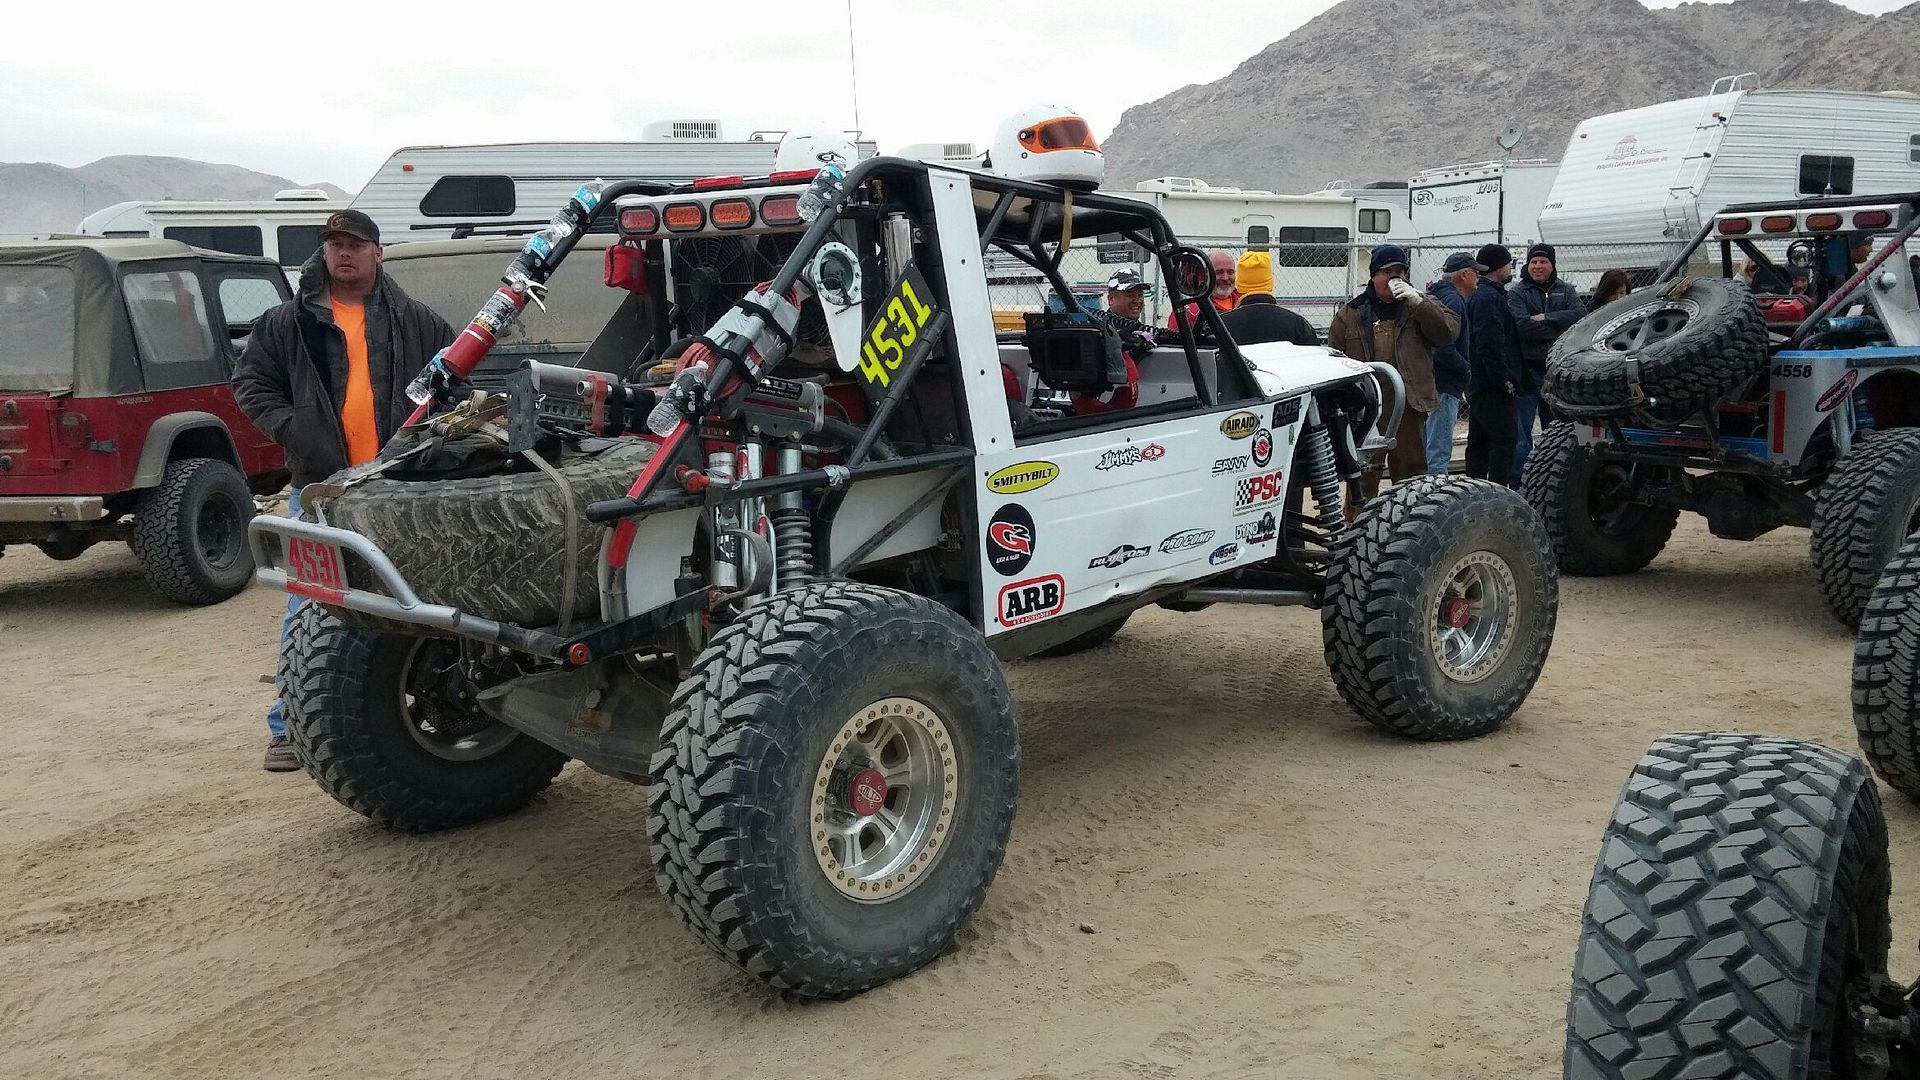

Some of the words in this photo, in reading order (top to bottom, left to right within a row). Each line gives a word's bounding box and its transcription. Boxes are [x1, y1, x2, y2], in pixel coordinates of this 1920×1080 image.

[858, 279, 932, 388] 4531
[1772, 364, 1813, 378] 4558
[1225, 416, 1256, 432] AIRAID
[1211, 454, 1251, 474] SAVVY
[993, 467, 1055, 489] SMITTYBILT
[1249, 471, 1282, 504] PSC
[1159, 538, 1183, 552] PRO
[1182, 530, 1215, 546] COMP
[288, 536, 343, 590] 4531
[1005, 582, 1059, 619] ARB
